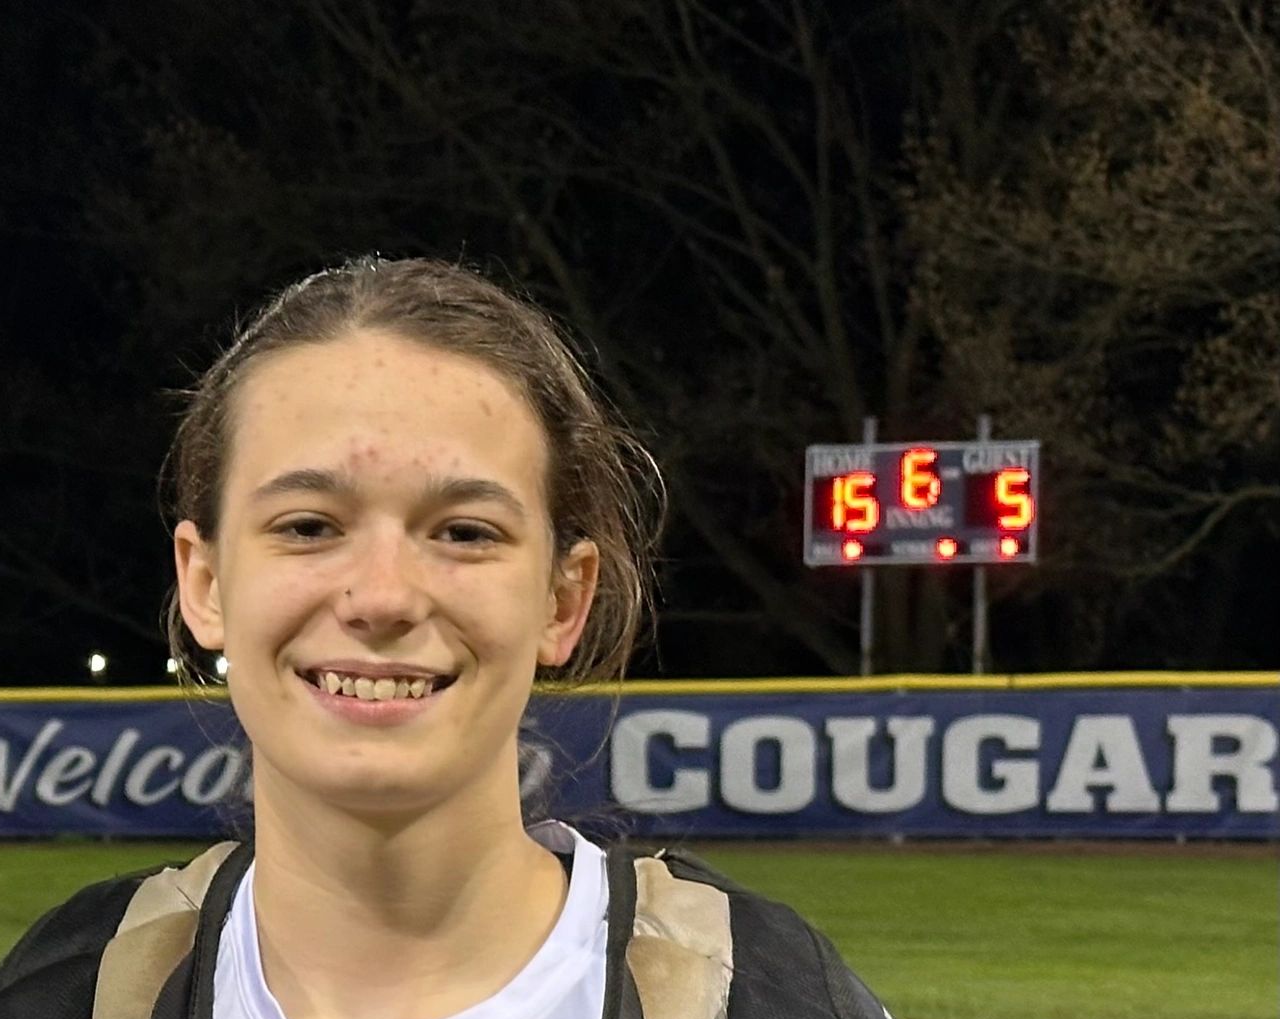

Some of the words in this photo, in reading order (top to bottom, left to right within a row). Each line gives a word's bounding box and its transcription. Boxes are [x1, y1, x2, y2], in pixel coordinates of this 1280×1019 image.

[832, 470, 880, 533] 15
[901, 447, 941, 510] 6
[995, 467, 1034, 530] 5
[611, 710, 1278, 815] COUGAR
